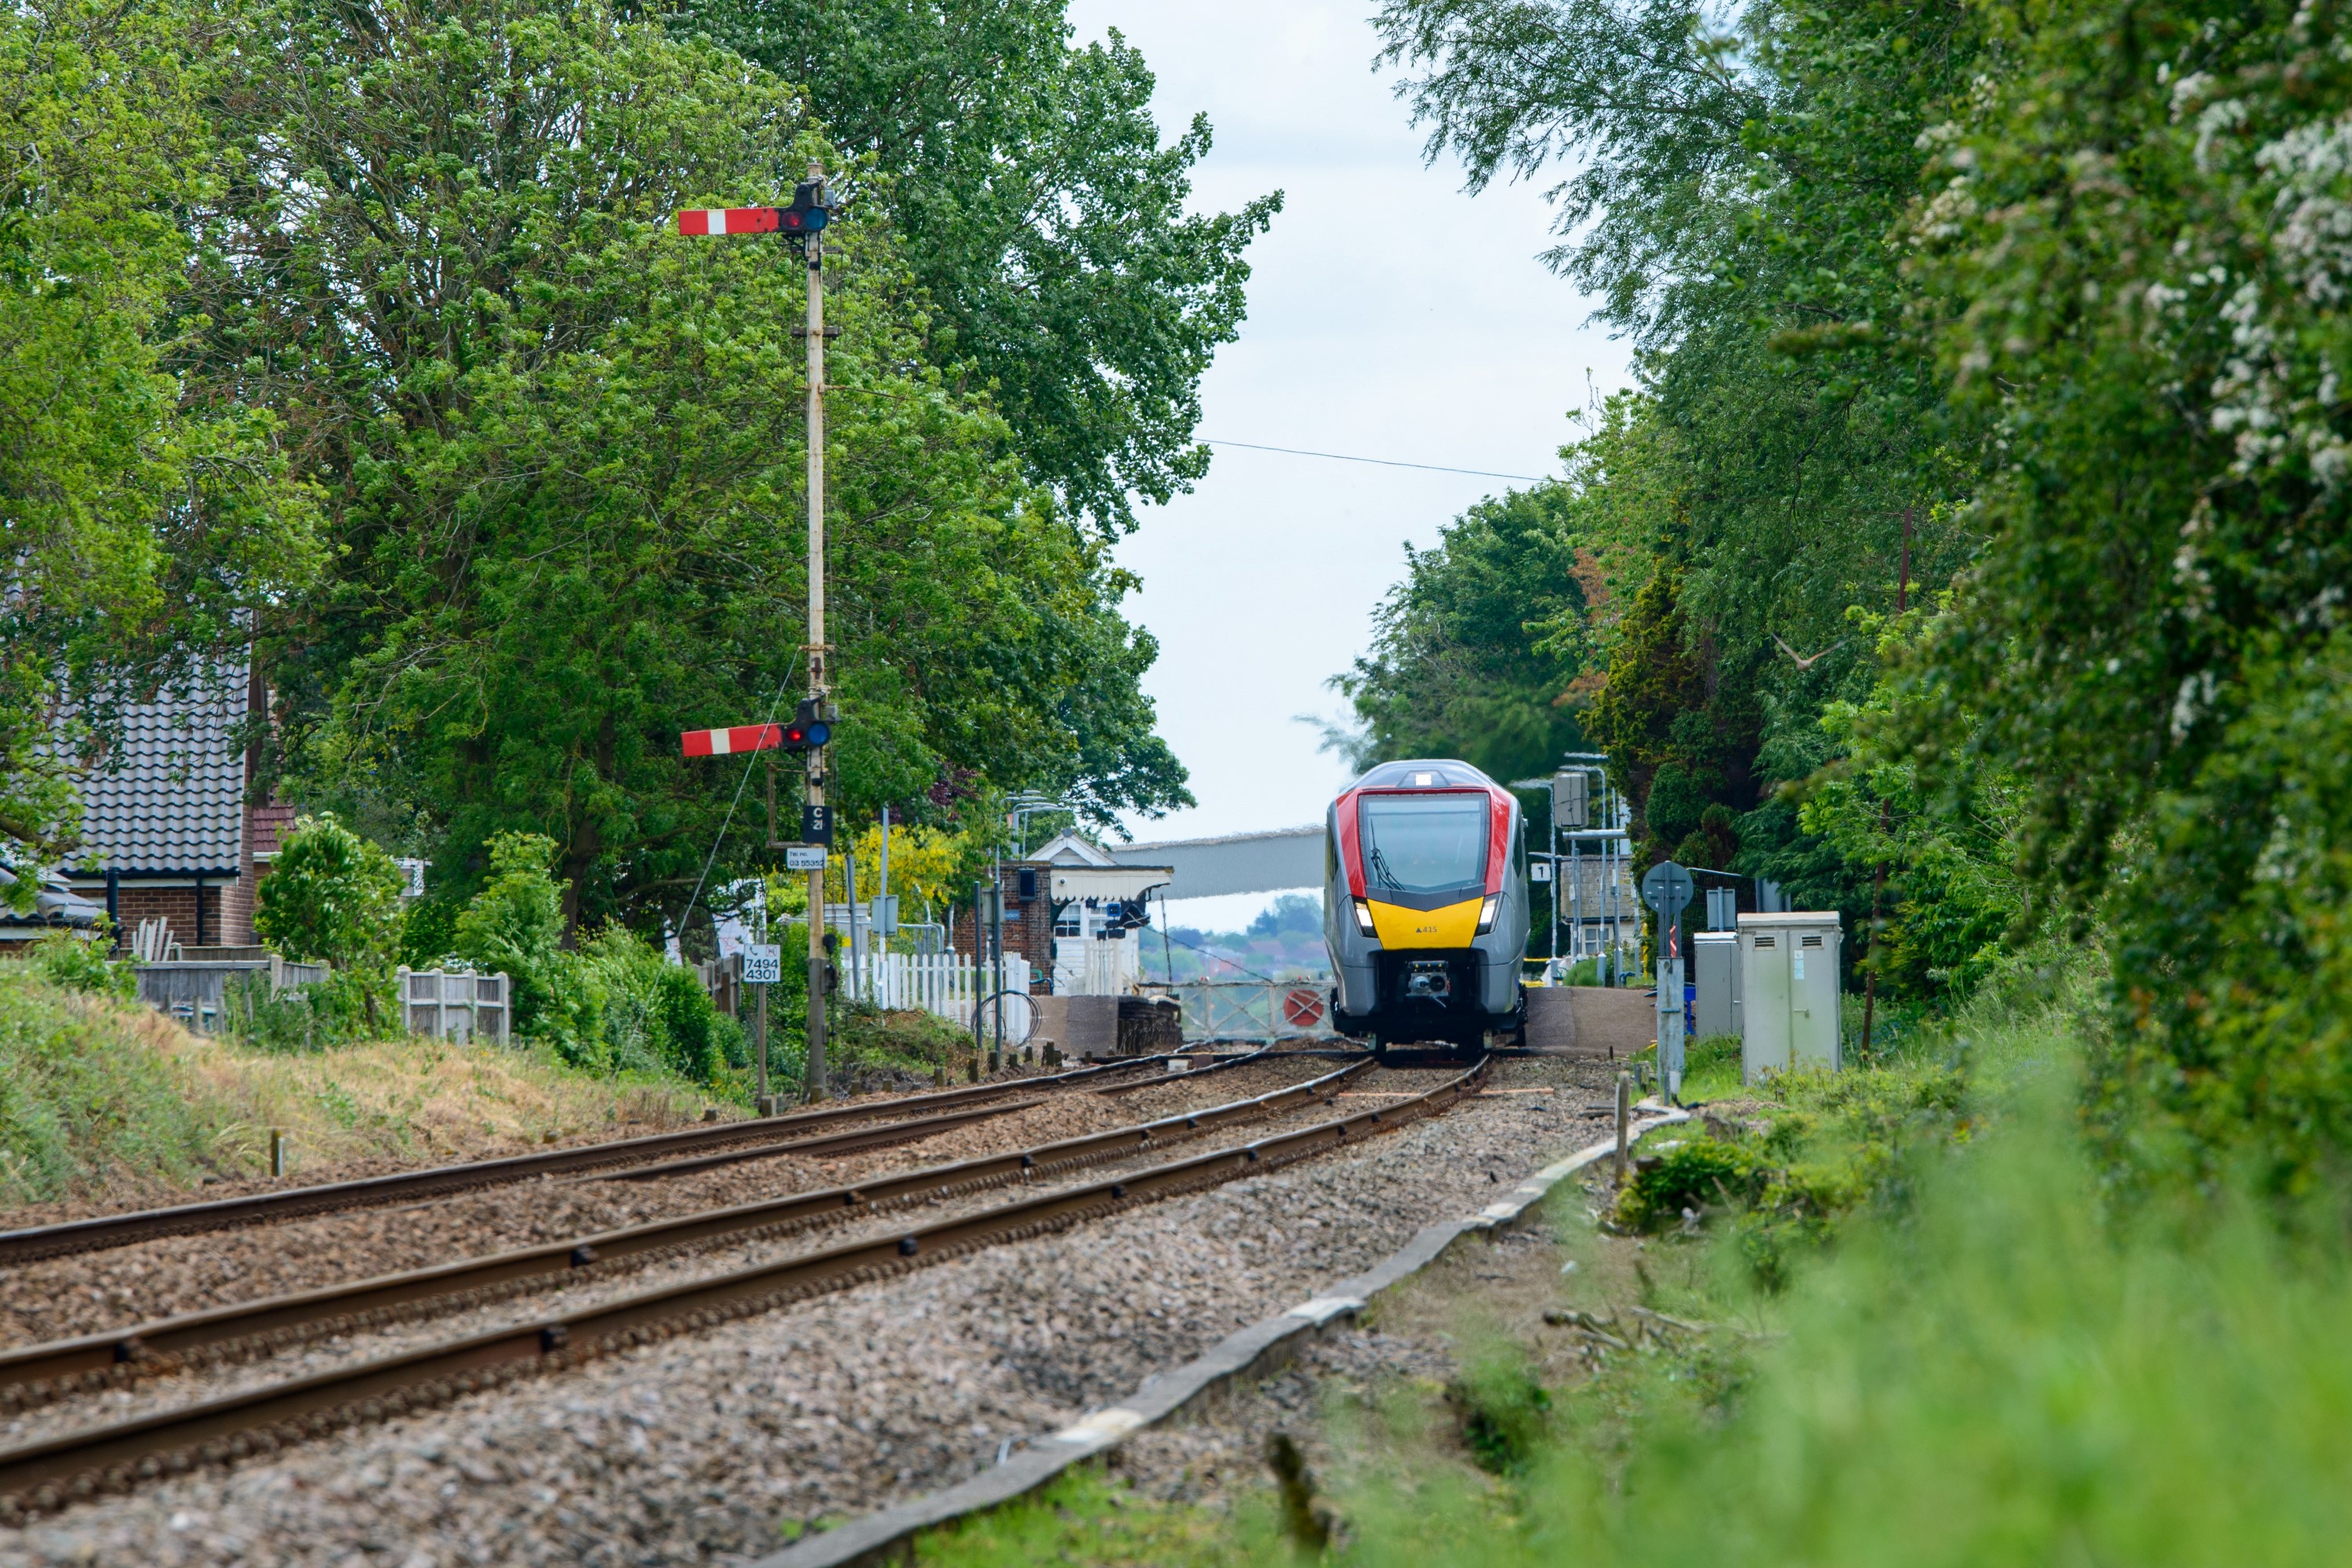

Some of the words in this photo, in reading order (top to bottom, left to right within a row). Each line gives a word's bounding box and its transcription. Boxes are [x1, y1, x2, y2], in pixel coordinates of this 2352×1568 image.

[813, 808, 822, 818] C
[813, 819, 822, 830] 21
[1537, 866, 1544, 878] 1
[746, 959, 779, 969] 7494
[746, 969, 775, 980] 4301
